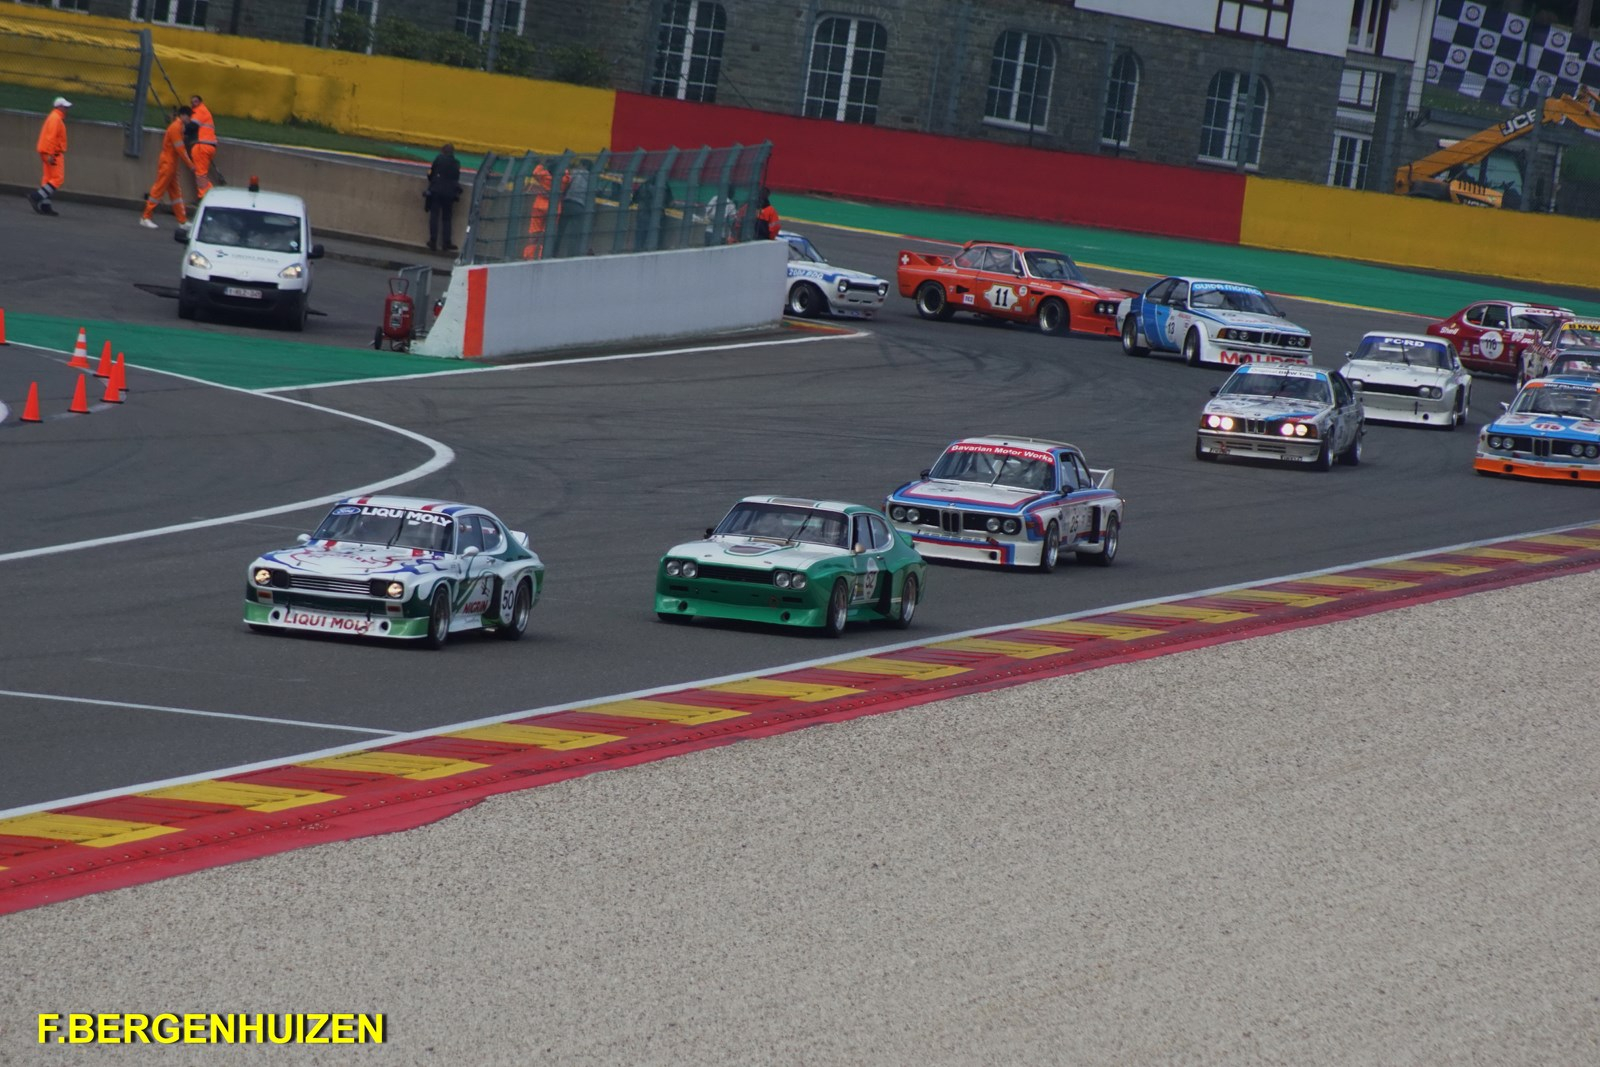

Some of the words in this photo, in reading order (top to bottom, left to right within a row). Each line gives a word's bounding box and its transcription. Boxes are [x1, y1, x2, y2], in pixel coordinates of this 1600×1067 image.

[994, 287, 1009, 307] 11
[1167, 321, 1176, 335] 13
[1439, 326, 1460, 335] Shell
[1568, 323, 1600, 331] BMW
[1384, 337, 1425, 347] FORD
[950, 444, 992, 453] Bavarian
[994, 447, 1022, 456] Motor
[1023, 450, 1053, 463] Works
[360, 506, 404, 518] LIQUI
[406, 511, 453, 527] MOLY
[502, 589, 515, 610] 50
[283, 612, 326, 627] LIQUI
[330, 616, 374, 632] MOLY
